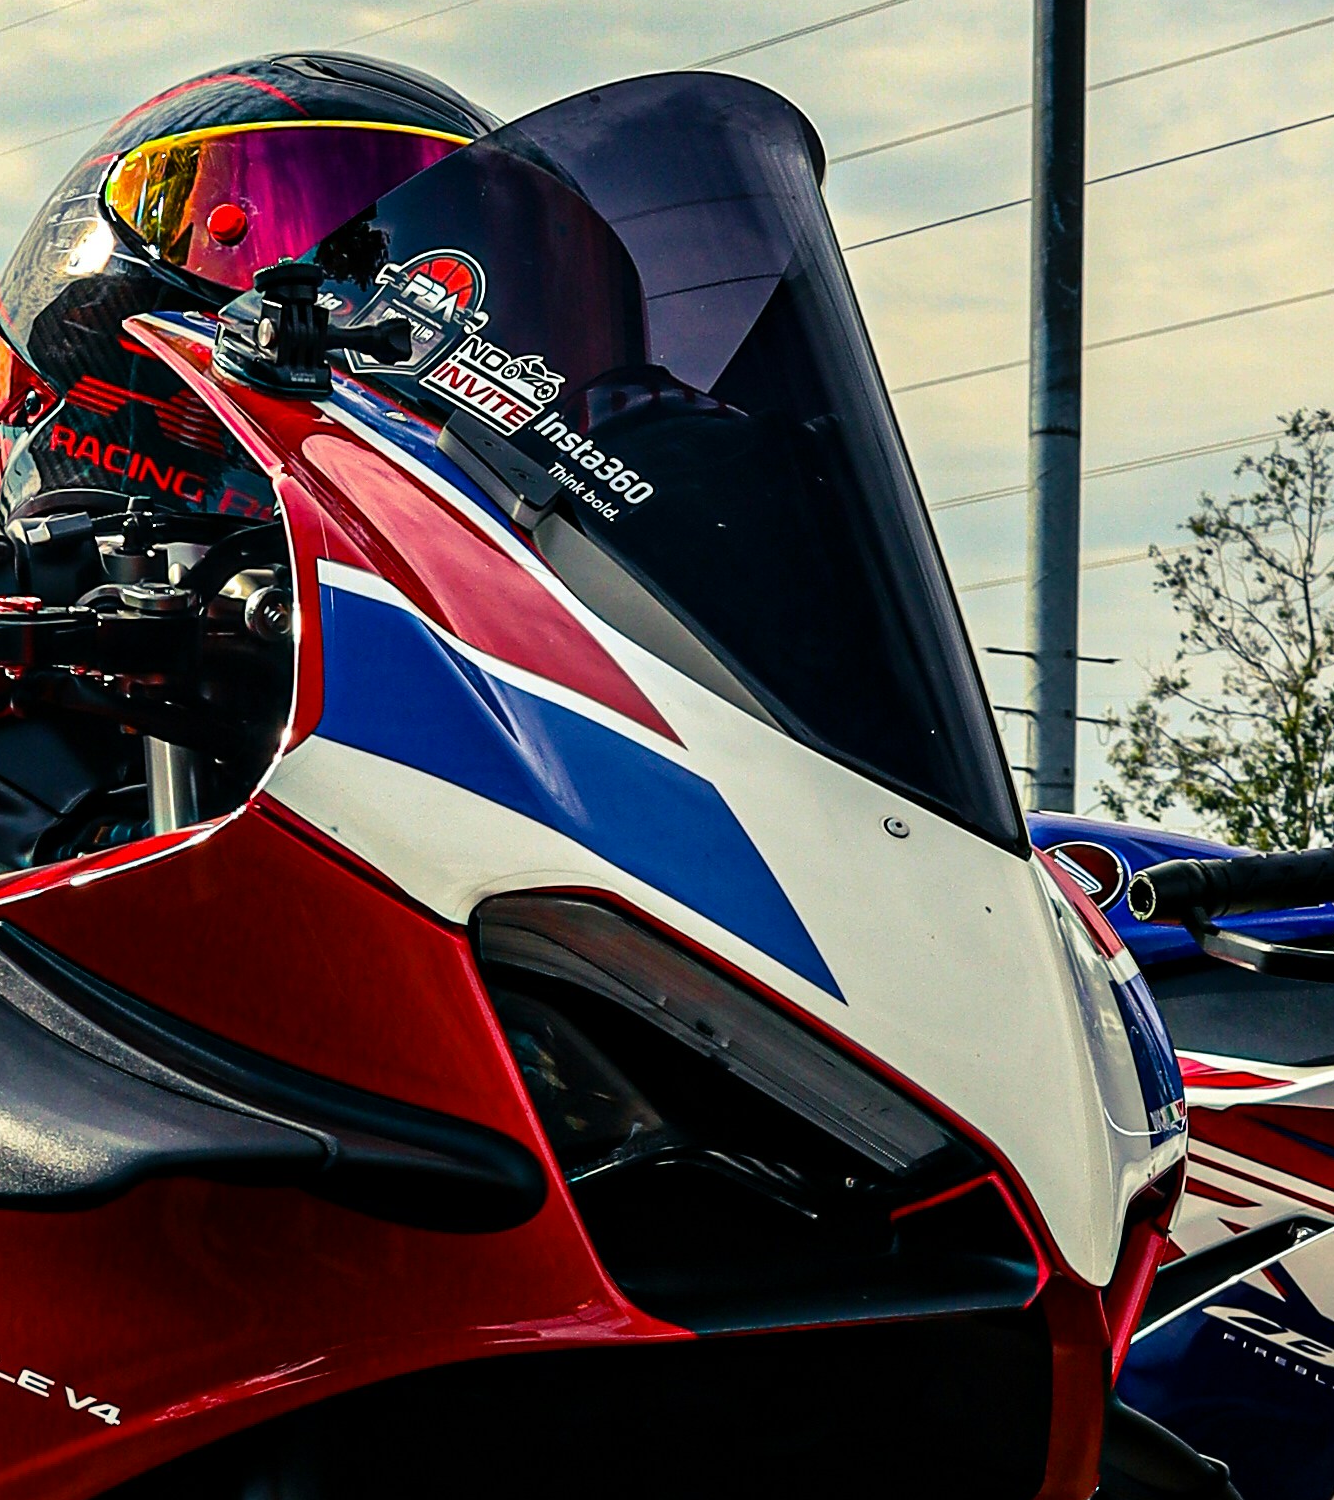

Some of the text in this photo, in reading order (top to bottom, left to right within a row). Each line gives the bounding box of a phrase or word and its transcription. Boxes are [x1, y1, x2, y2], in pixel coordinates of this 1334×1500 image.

[400, 273, 458, 323] PBA
[464, 337, 506, 373] NO
[432, 361, 533, 427] INVITE
[50, 423, 207, 504] RACING
[534, 412, 654, 505] Insta360
[547, 462, 620, 522] Think bold.
[65, 1386, 121, 1426] V4
